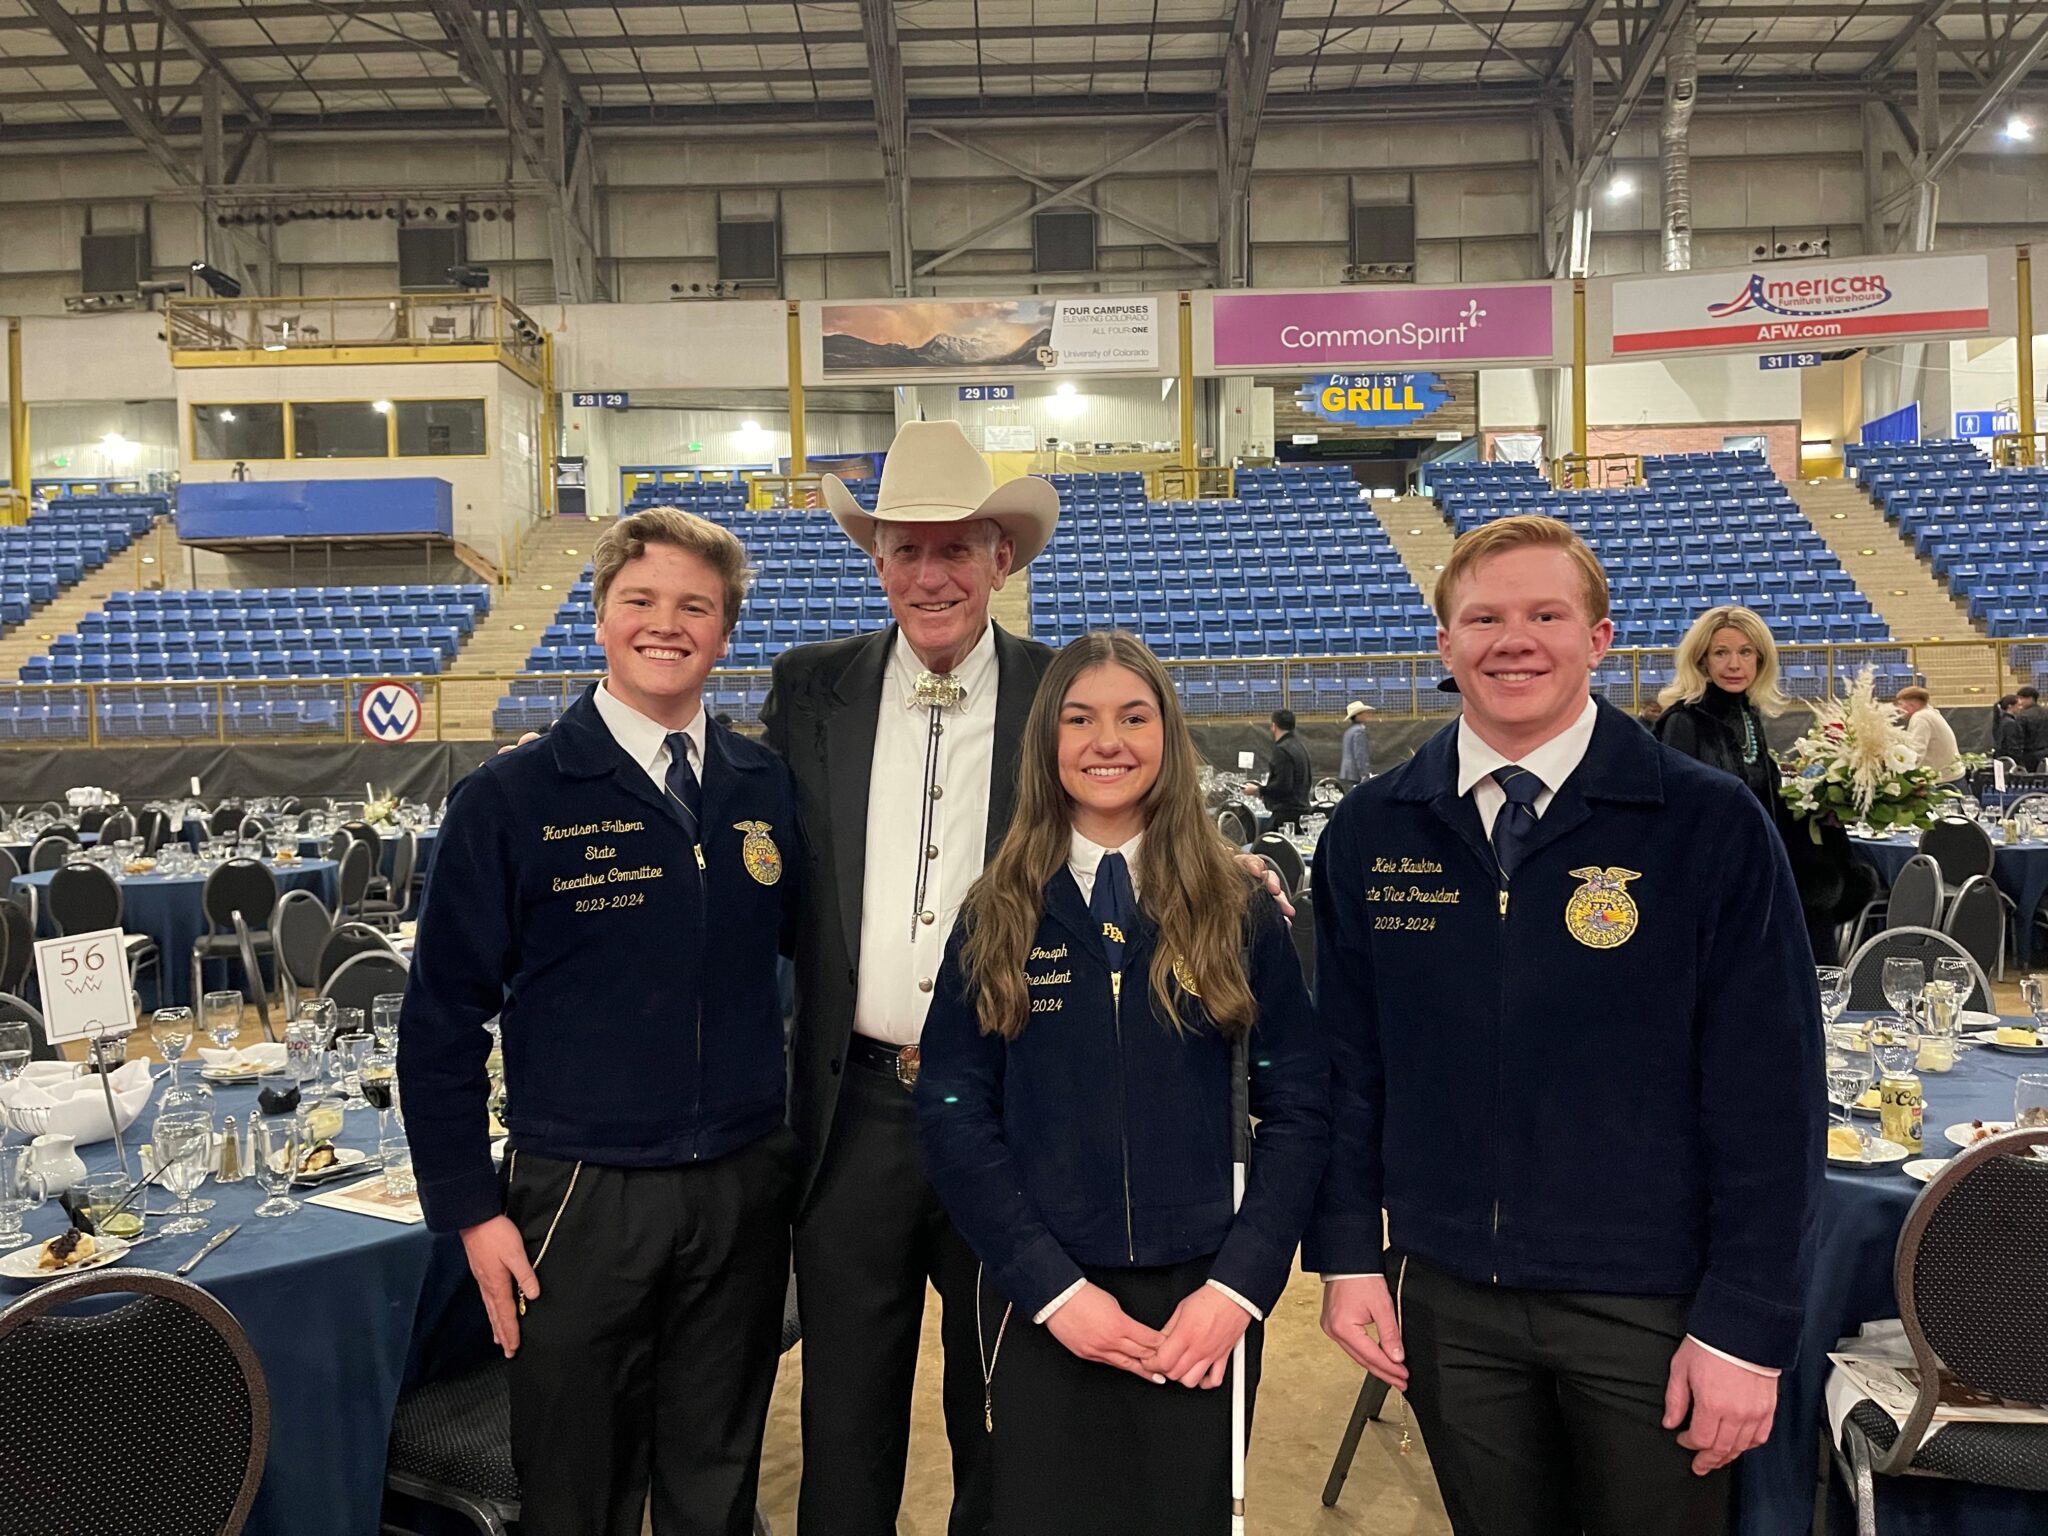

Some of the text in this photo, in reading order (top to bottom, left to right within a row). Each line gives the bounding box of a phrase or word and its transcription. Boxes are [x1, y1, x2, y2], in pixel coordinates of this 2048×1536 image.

[1778, 292, 1883, 307] Furniture Warehouse
[1063, 305, 1149, 315] FOUR CAMPUSES
[1063, 314, 1149, 323] ELEVATING COLORADO
[1092, 327, 1105, 335] ALL
[1281, 321, 1468, 350] CommonSpirit
[1757, 323, 1841, 340] AFW.com
[1063, 348, 1149, 359] University of Colorado
[1768, 354, 1814, 367] 31 32
[1354, 377, 1370, 388] 30
[1384, 376, 1397, 387] 31
[579, 395, 622, 405] 28 29
[965, 386, 1008, 399] 29 30
[1321, 386, 1424, 412] GRILL
[542, 823, 600, 841] Harrison
[585, 845, 617, 860] State
[552, 865, 664, 892] Executive Committee
[575, 892, 645, 912] 2023-2024
[1383, 885, 1406, 902] Vice
[1406, 885, 1460, 904] President
[1590, 901, 1614, 911] FFA
[1374, 916, 1437, 931] 2023-2024
[1102, 922, 1126, 943] FFA
[60, 942, 105, 976] 56
[1030, 943, 1068, 963] Joseph
